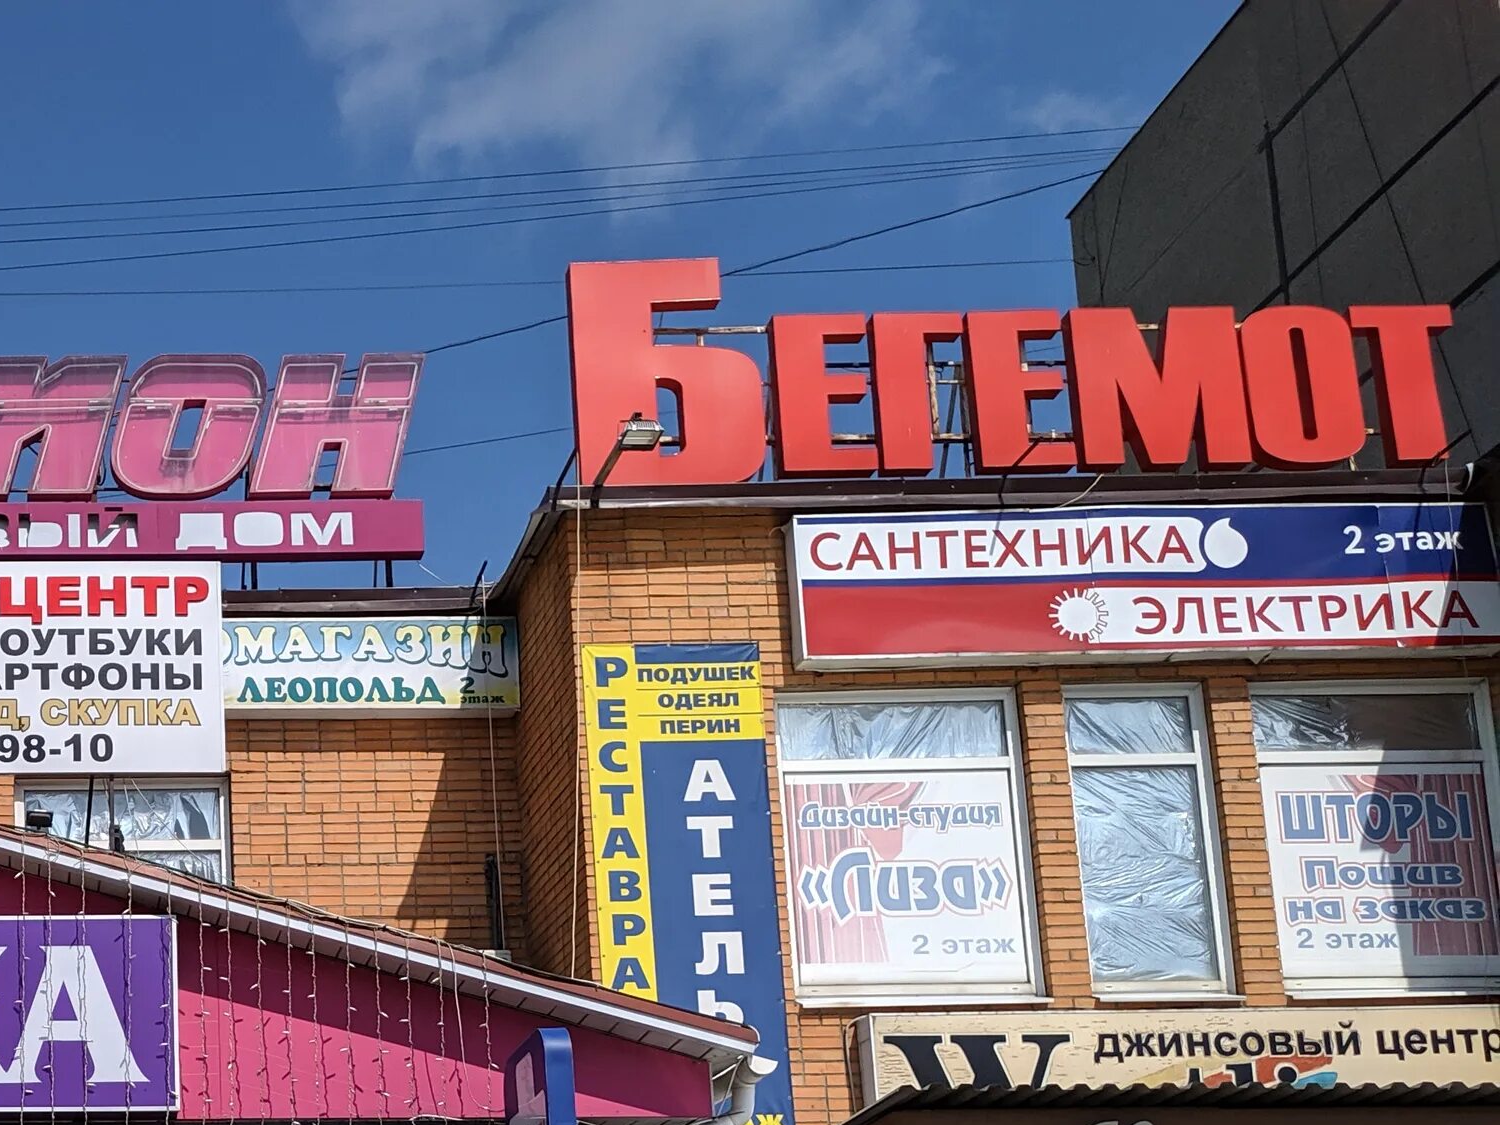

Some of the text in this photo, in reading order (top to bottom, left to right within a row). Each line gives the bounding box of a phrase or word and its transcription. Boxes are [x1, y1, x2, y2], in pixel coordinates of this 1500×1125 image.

[566, 257, 1453, 486] БЕГЕМОТ
[175, 512, 353, 551] ДОМ
[810, 523, 1464, 571] САНТЕХНИКА 2 этаж
[0, 575, 211, 625] ЦЕНТР
[1134, 589, 1480, 635] ЭЛЕКТРИКА
[637, 665, 756, 685] ПОДУШЕК
[237, 676, 475, 705] ЛЕОПОЛЬД 2
[658, 692, 740, 710] ОДЕЯЛ
[40, 698, 202, 728] СКУПКА
[660, 718, 741, 734] ПЕРИН
[801, 803, 1001, 832] Дизайн-студия
[1279, 791, 1475, 842] ШТОРЫ
[1303, 859, 1464, 890] Пошив
[1286, 898, 1488, 923] на заказ
[911, 934, 1017, 955] 2 этаж
[1296, 928, 1399, 949] 2 этаж
[1094, 1021, 1361, 1063] джинсовый
